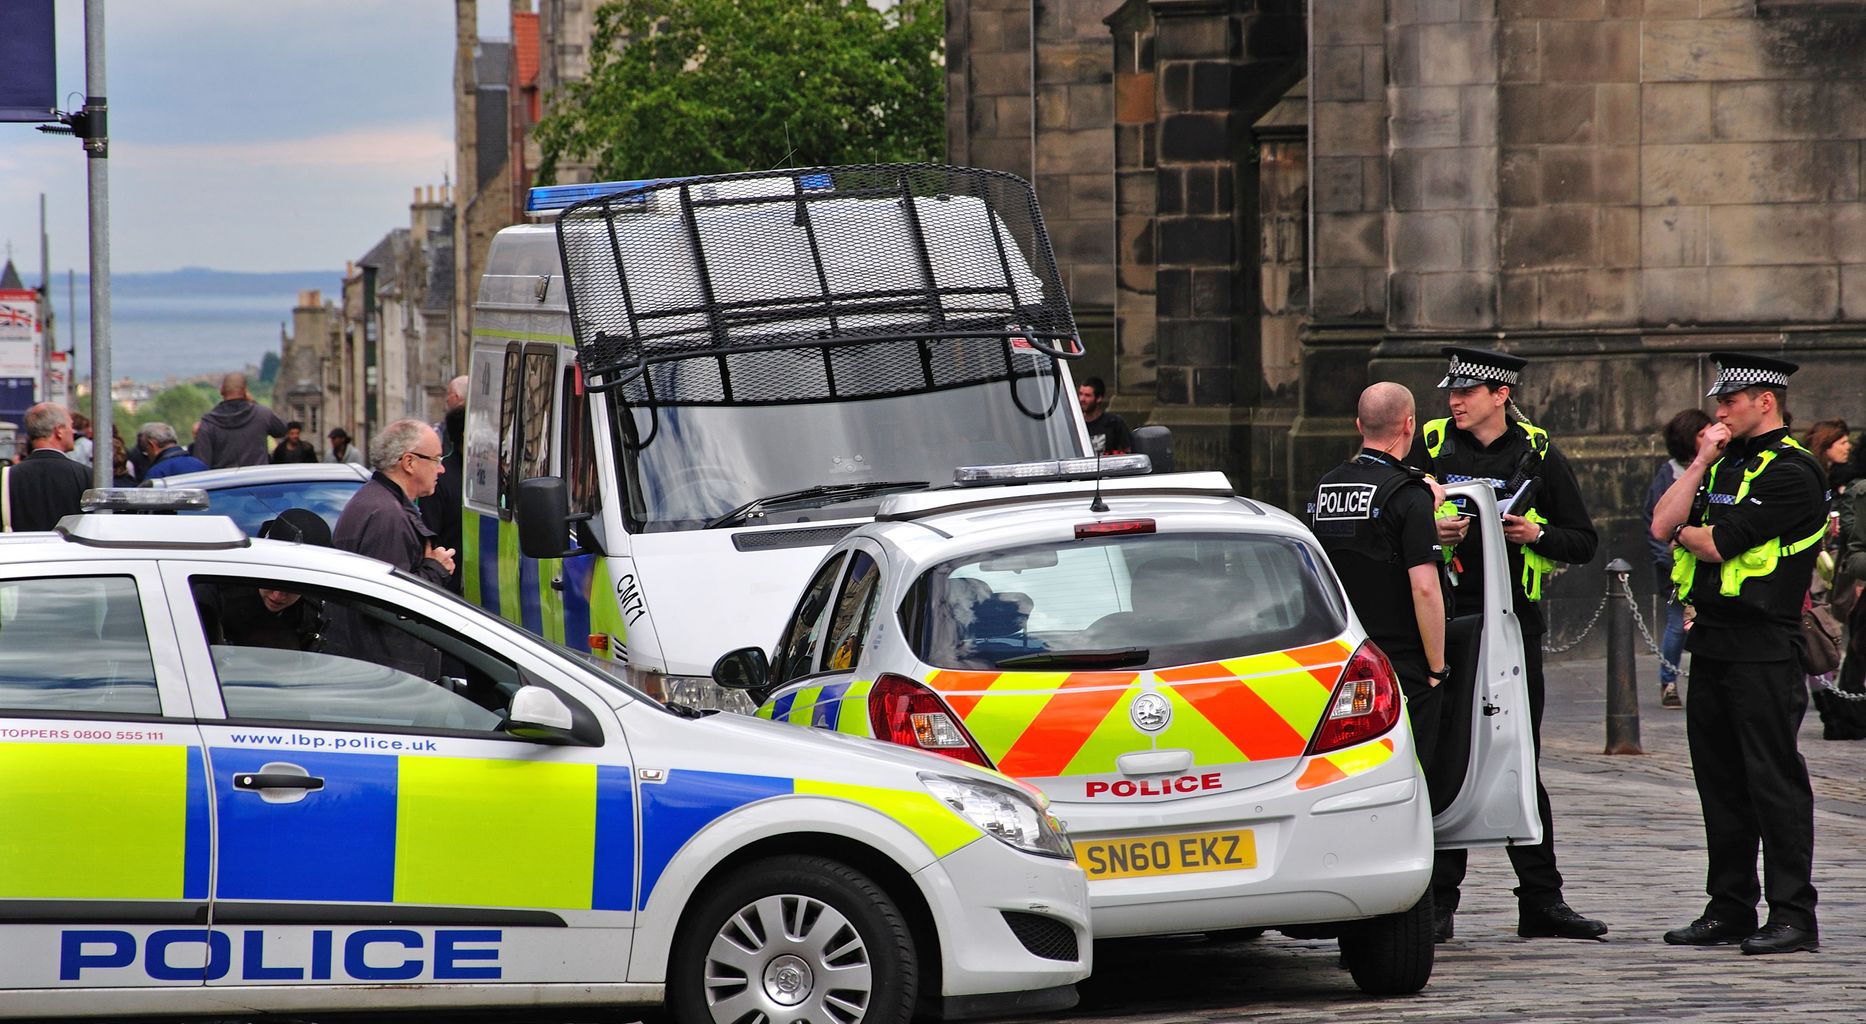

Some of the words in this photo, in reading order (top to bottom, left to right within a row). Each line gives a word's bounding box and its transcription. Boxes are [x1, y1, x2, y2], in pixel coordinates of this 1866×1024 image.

[1319, 491, 1371, 513] POLICE
[617, 573, 646, 627] CM71
[73, 730, 112, 740] 0800
[115, 731, 143, 740] 555
[146, 732, 164, 741] 111
[231, 733, 438, 751] www.lbp.police.uk
[1086, 772, 1223, 798] POLICE
[1087, 841, 1171, 875] SN60
[1179, 835, 1243, 868] EKZ
[59, 930, 503, 981] POLICE
